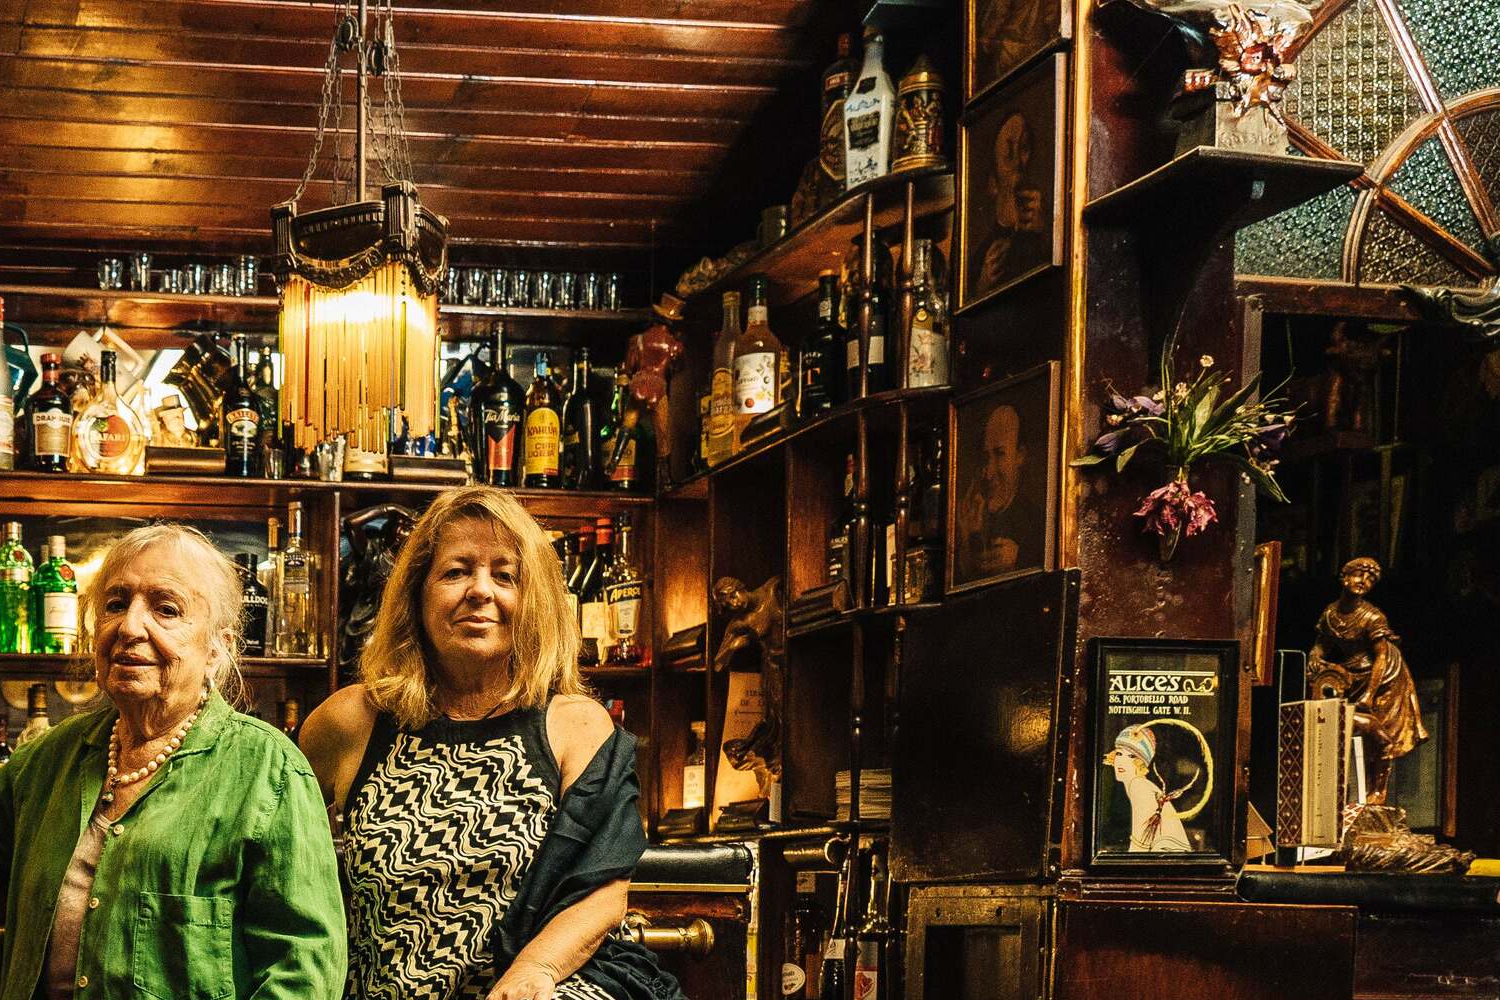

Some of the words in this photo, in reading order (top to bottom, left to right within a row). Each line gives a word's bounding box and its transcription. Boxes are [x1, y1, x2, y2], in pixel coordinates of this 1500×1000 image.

[35, 415, 71, 423] DRAMUIE
[485, 410, 499, 422] Tia
[497, 406, 521, 422] Maria
[241, 595, 269, 605] ULLDO
[1122, 695, 1166, 705] PORTOBELLO
[1168, 695, 1189, 705] ROAD
[1152, 706, 1171, 715] GATE
